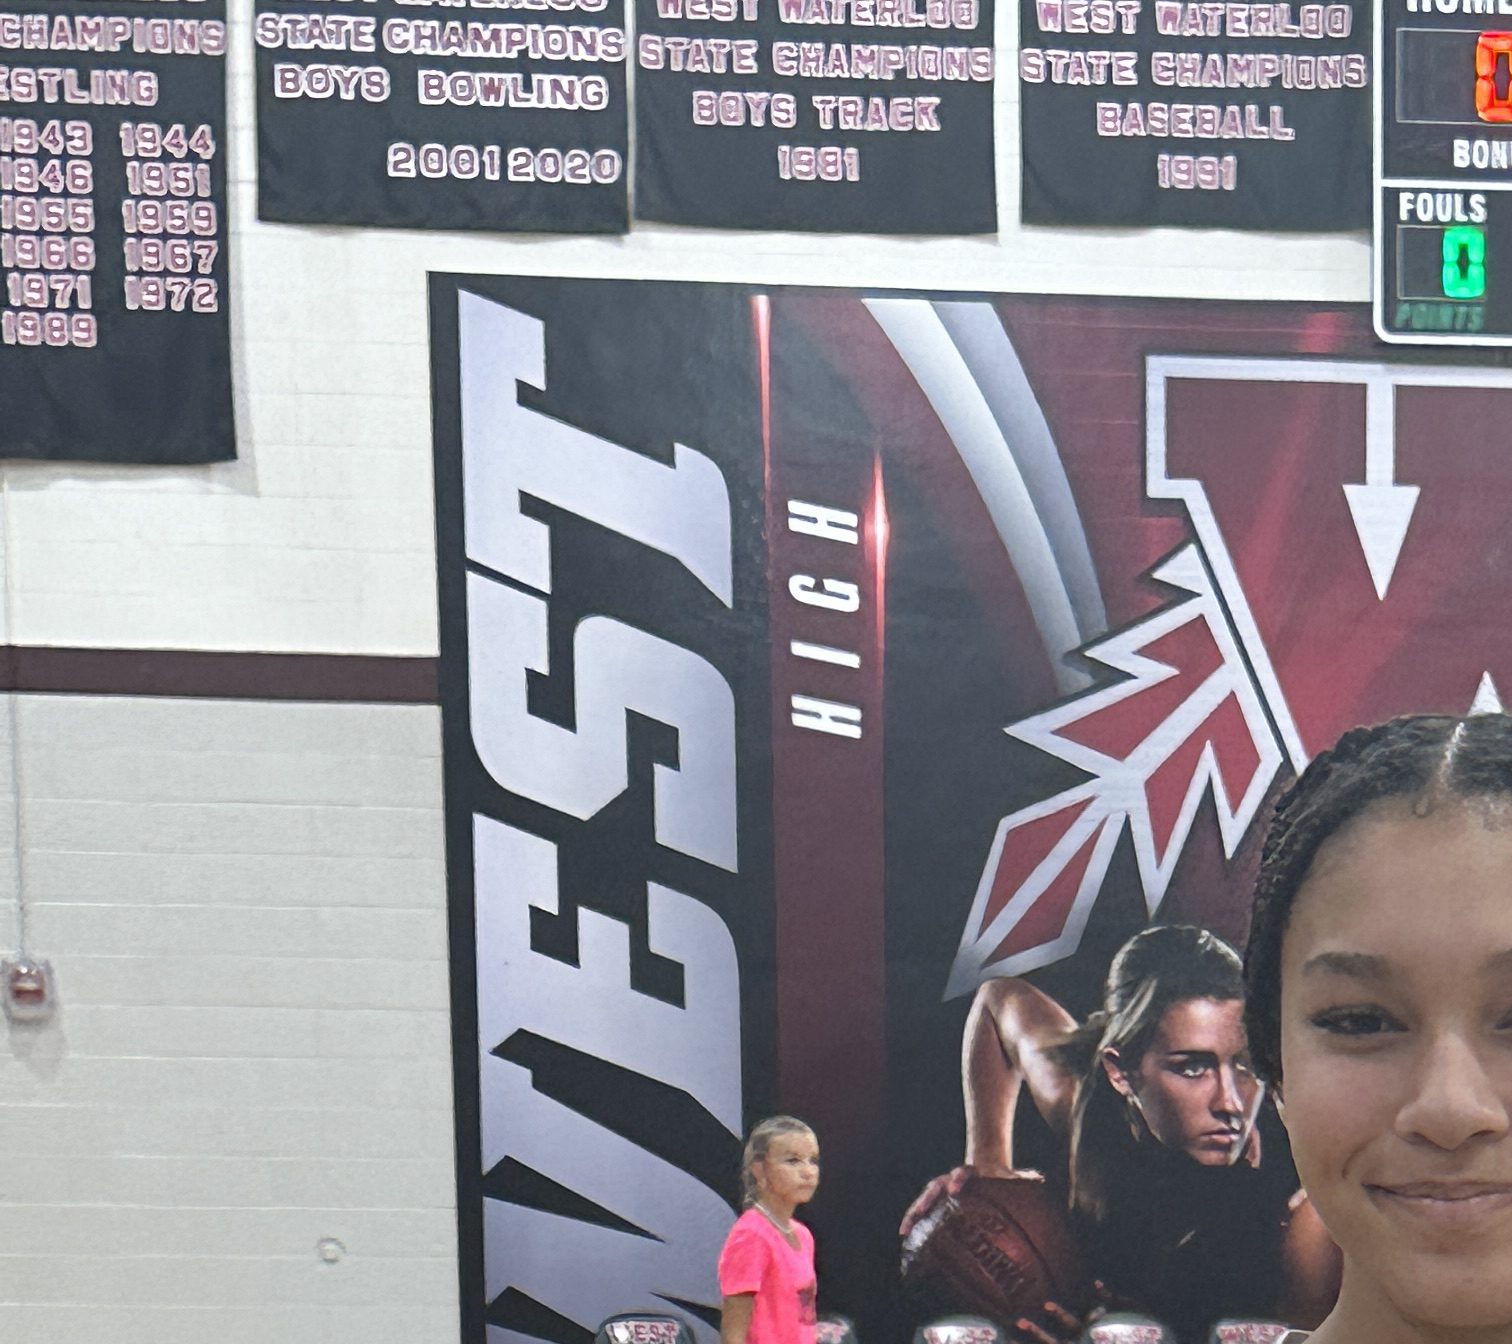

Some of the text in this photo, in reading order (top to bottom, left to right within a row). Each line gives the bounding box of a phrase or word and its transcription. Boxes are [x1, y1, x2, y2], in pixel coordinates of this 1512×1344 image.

[0, 13, 225, 56] CHAMPIONS
[778, 0, 979, 30] WATERLOO
[1036, 2, 1353, 39] WEST WATERLOO
[256, 13, 626, 62] STATE CHAMPIONS
[639, 34, 995, 81] STATE CHAMPIONS
[275, 63, 609, 110] BOYS BOWLING
[1020, 48, 1367, 90] STATE CHAMPIONS
[692, 91, 941, 132] BOYS TRACK
[1097, 102, 1296, 140] BASEBALL
[0, 117, 216, 159] 1943 1944
[0, 156, 212, 197] 1946 1951
[387, 143, 622, 183] 2001 2020
[1158, 154, 1238, 190] 1991
[0, 195, 217, 236] 1955 1959
[1399, 192, 1487, 223] FOULS
[1, 233, 218, 274] 1966 1967
[1442, 226, 1485, 299] 0
[7, 272, 218, 313] 1971 1972
[2, 311, 97, 347] 1989
[787, 499, 862, 739] HIGH
